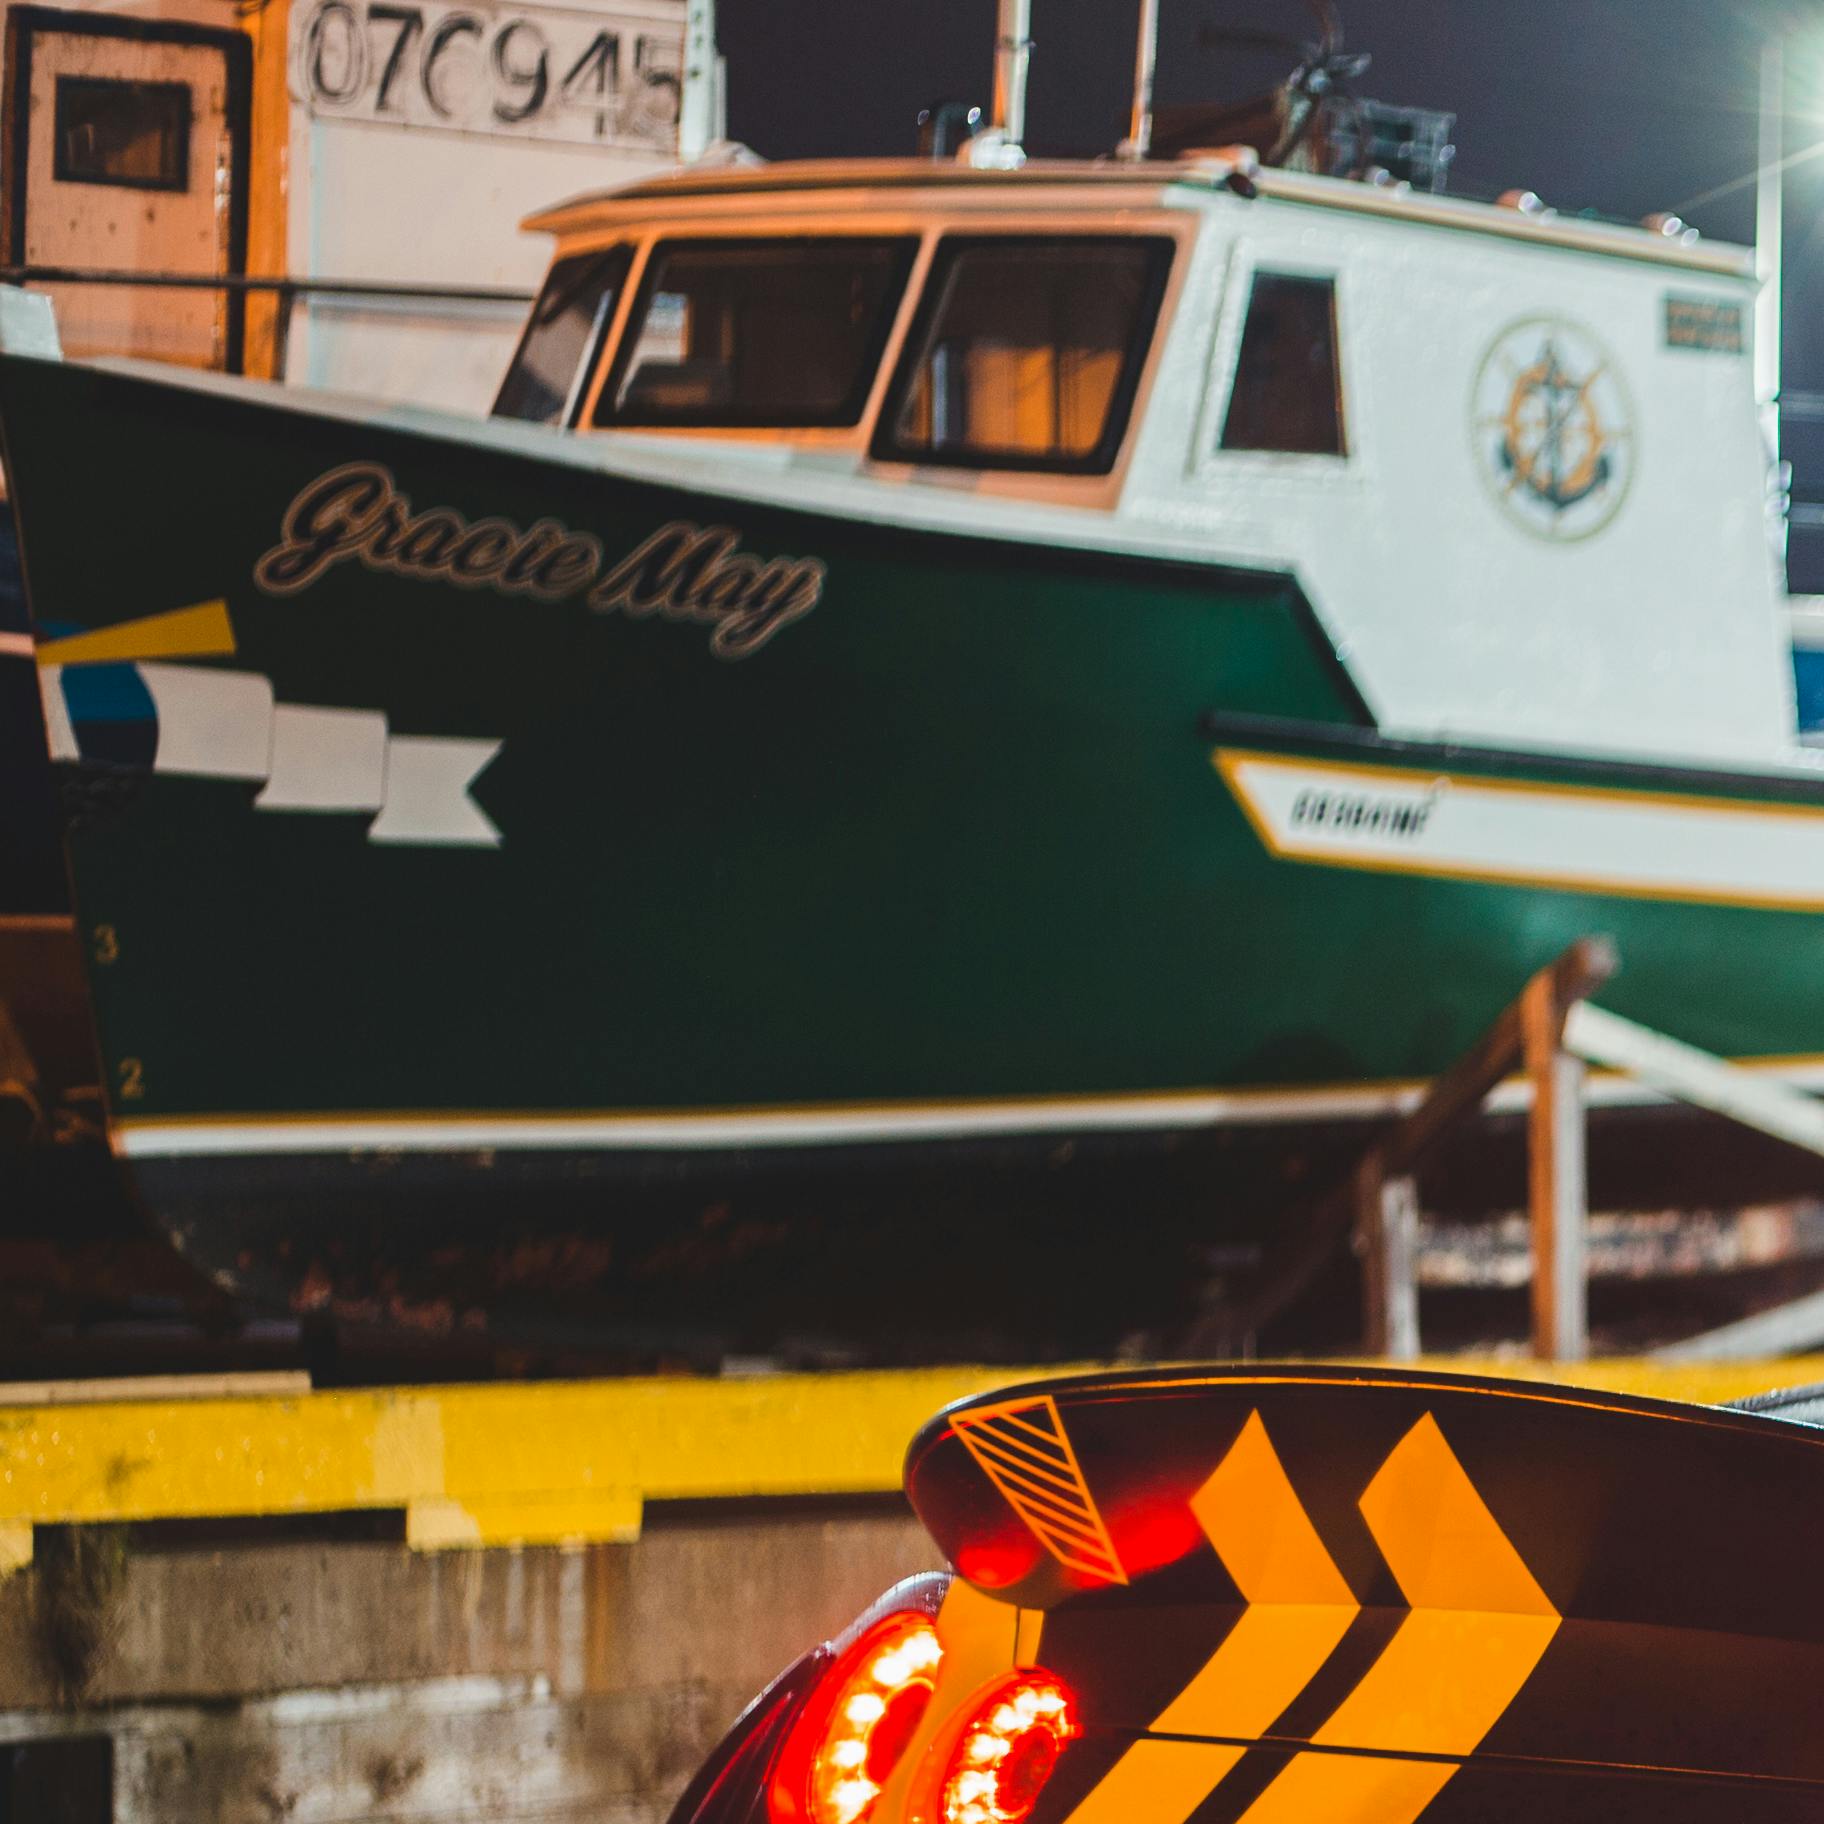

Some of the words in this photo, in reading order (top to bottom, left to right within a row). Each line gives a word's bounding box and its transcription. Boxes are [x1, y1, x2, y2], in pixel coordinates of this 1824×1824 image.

[254, 461, 602, 598] Gracie
[592, 520, 828, 662] May
[94, 924, 119, 965] 3
[119, 1057, 145, 1099] 2
